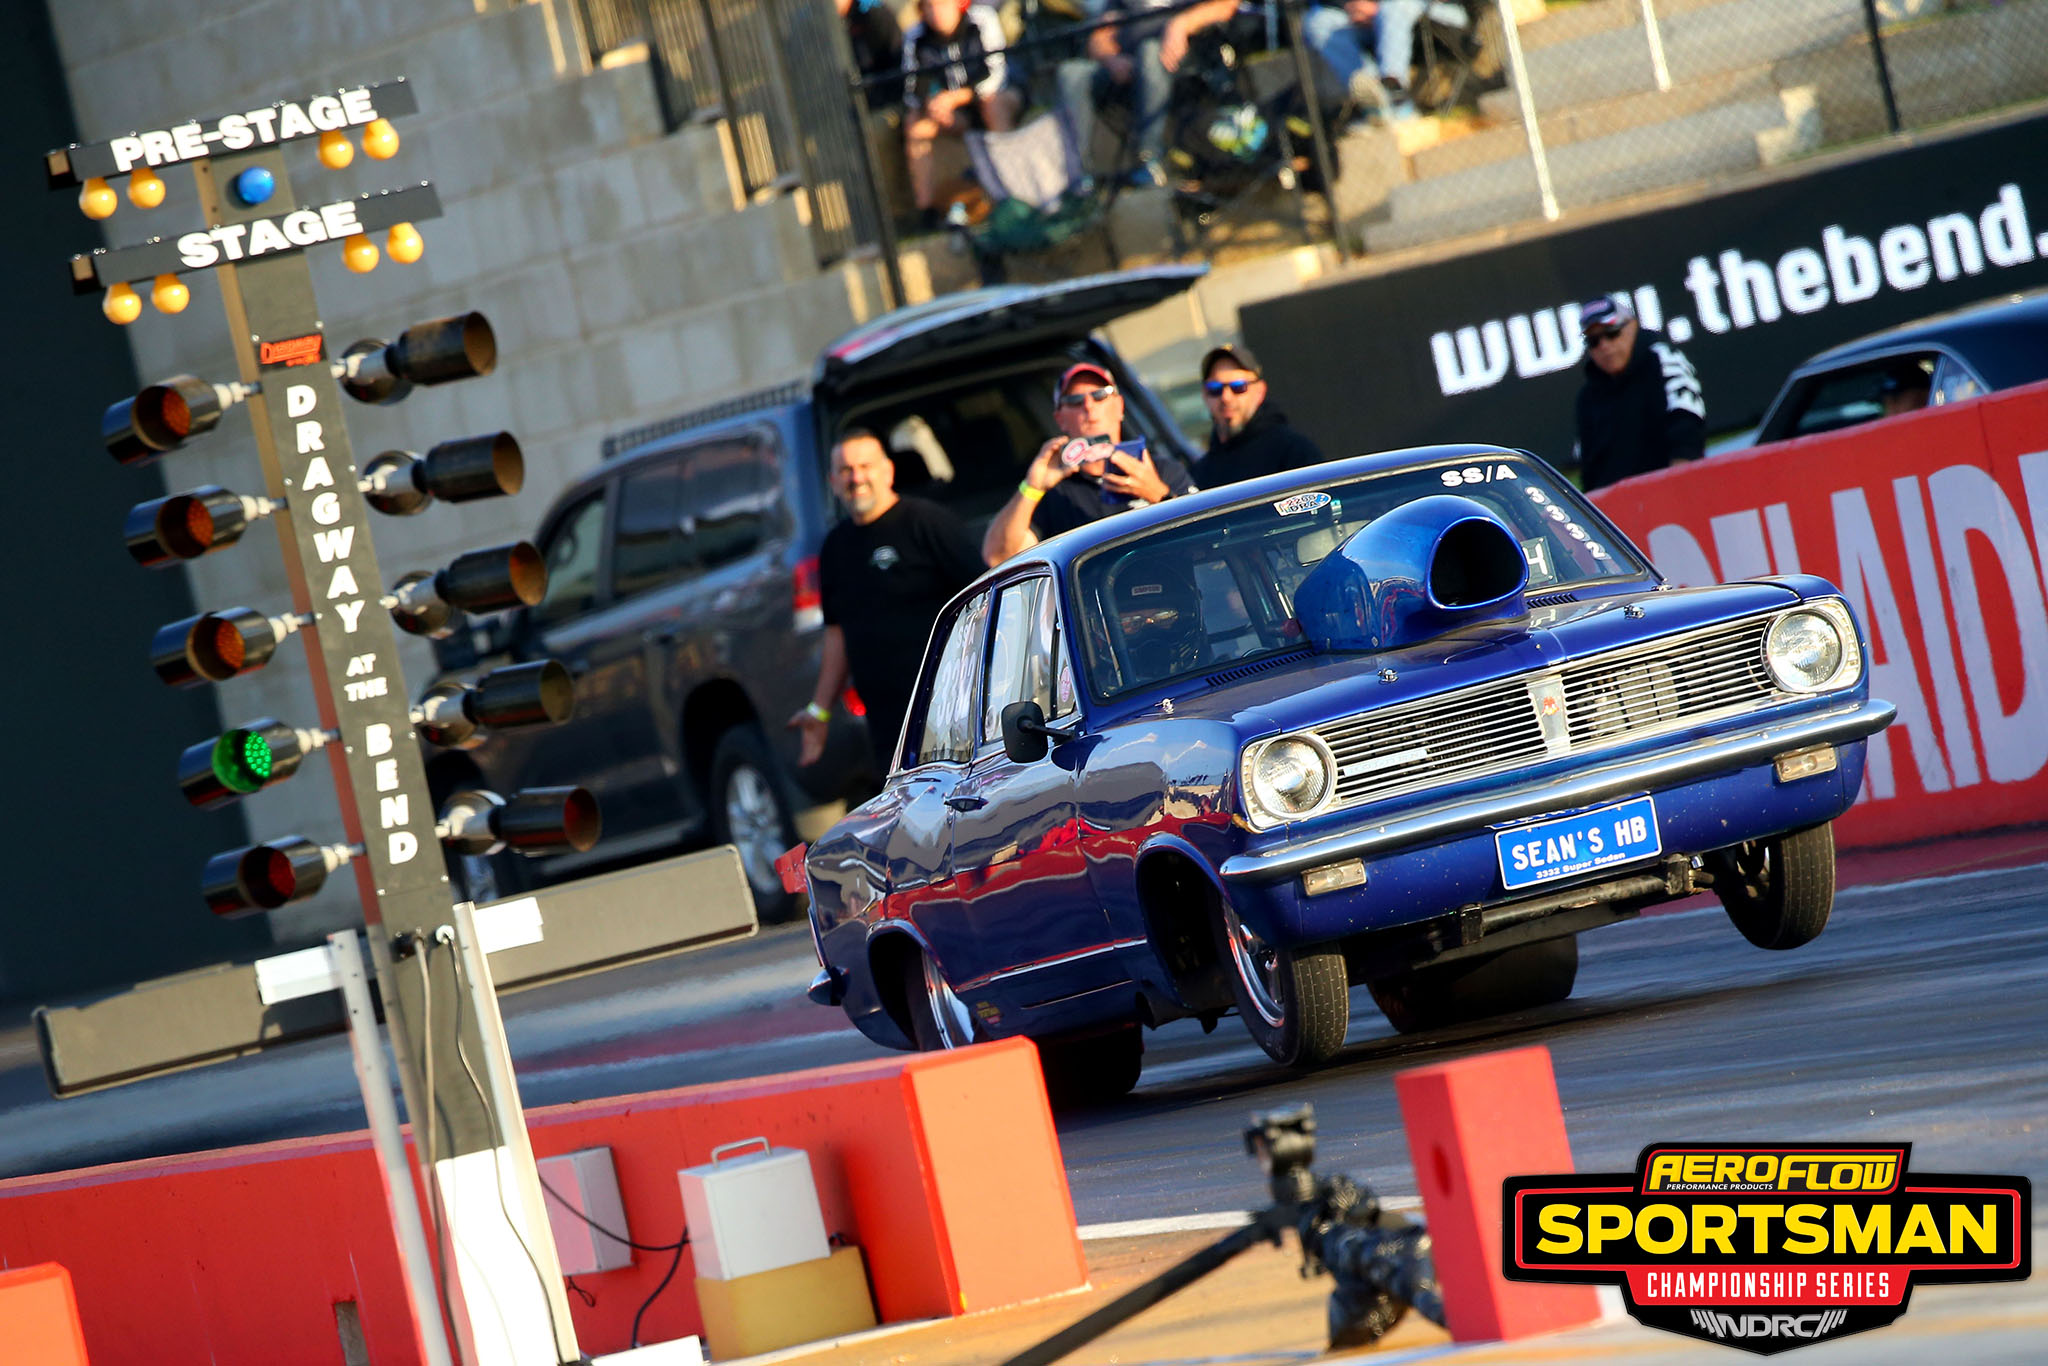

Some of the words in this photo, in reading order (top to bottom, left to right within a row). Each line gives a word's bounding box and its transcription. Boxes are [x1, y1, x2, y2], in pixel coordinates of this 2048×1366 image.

[110, 89, 379, 173] PRE-STAGE
[177, 201, 364, 269] STAGE
[1440, 464, 1518, 487] SS/A
[286, 384, 367, 634] DRAGWAY
[1524, 486, 1612, 560] 3332
[344, 677, 388, 702] THE
[346, 653, 376, 677] AT
[365, 722, 419, 865] BEND
[1511, 827, 1604, 871] SEAN'S
[1613, 816, 1648, 847] HB
[1562, 861, 1592, 873] Super
[1594, 852, 1626, 865] Sedan
